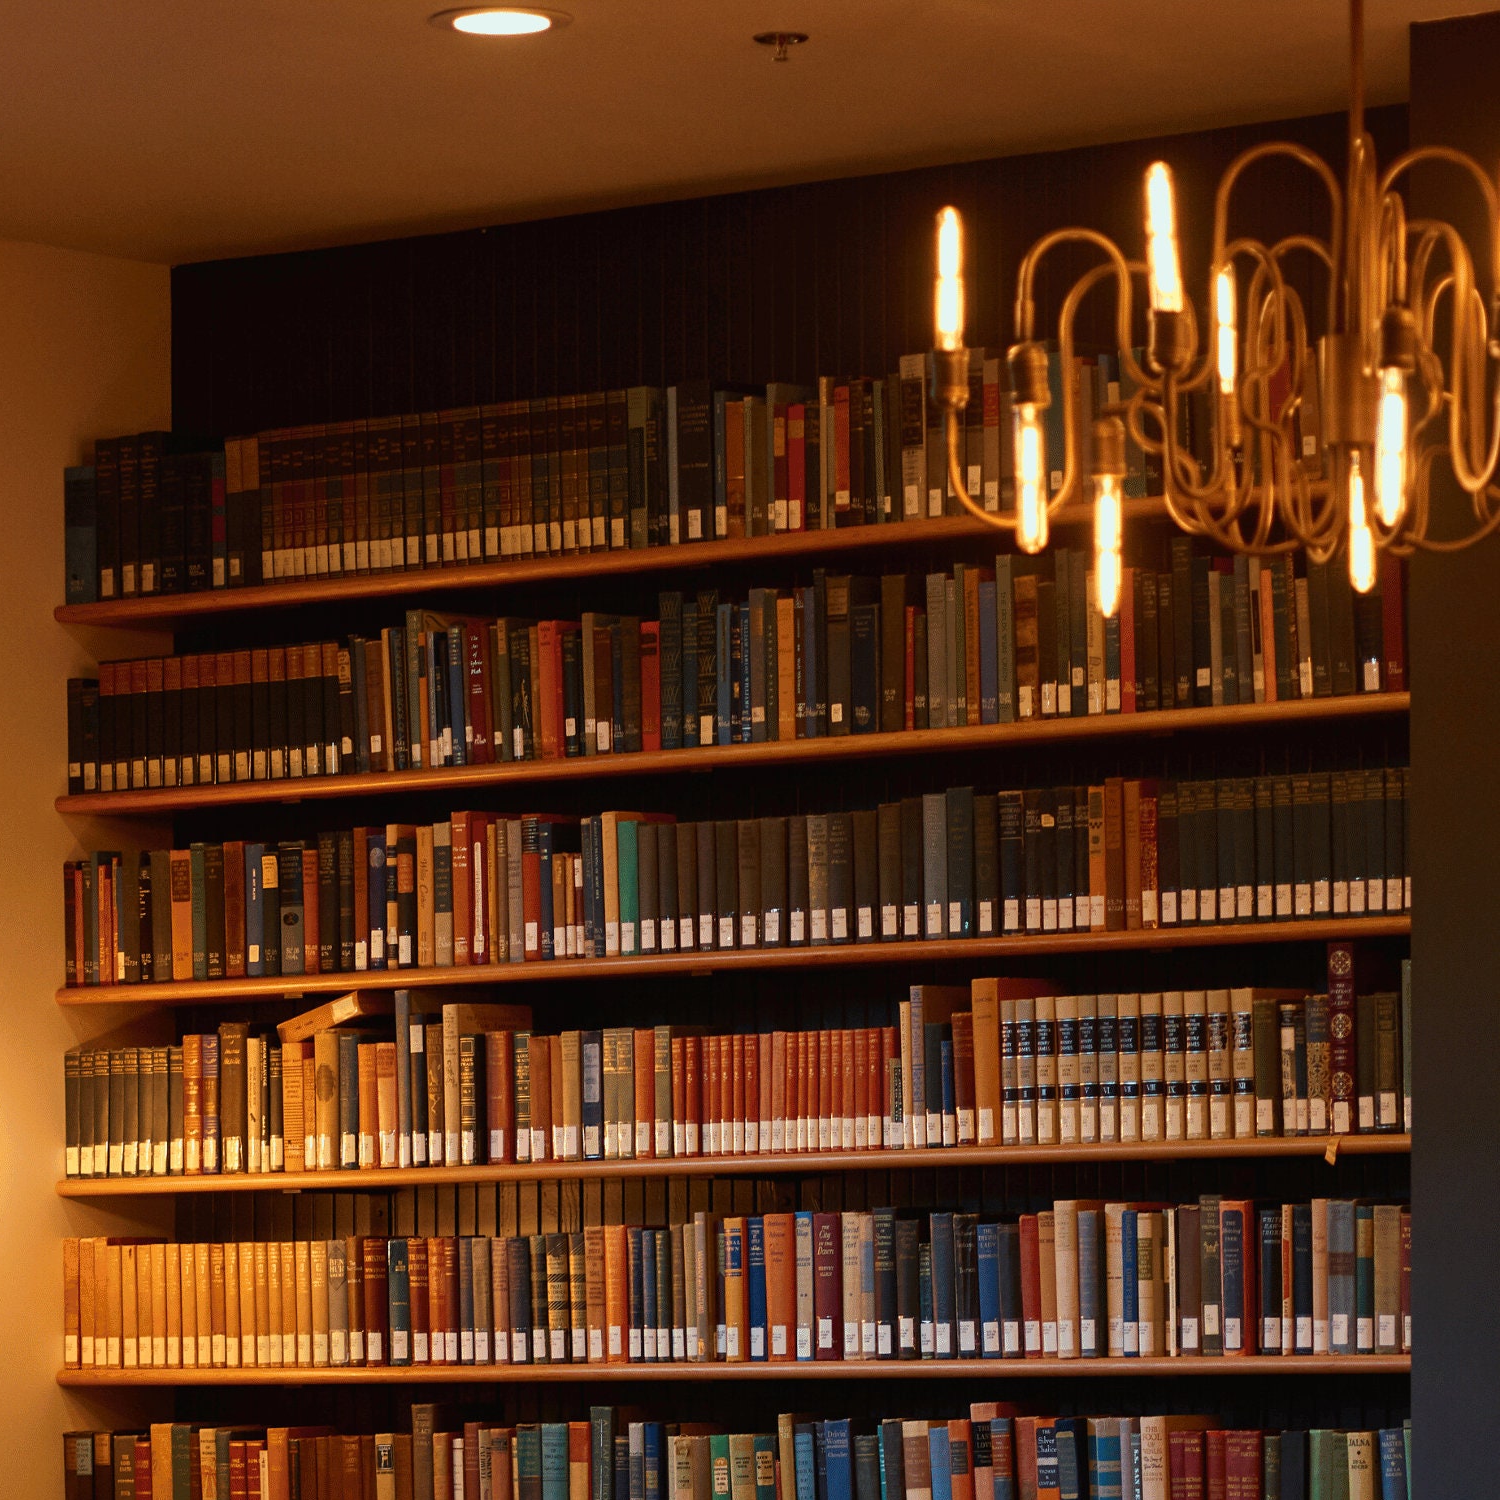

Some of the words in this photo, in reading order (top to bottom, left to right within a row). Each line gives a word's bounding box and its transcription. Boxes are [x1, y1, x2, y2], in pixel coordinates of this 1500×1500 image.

[819, 1230, 832, 1241] City
[1038, 1435, 1055, 1444] Silver
[1348, 1439, 1371, 1447] JALNA
[1038, 1444, 1058, 1453] Chalice
